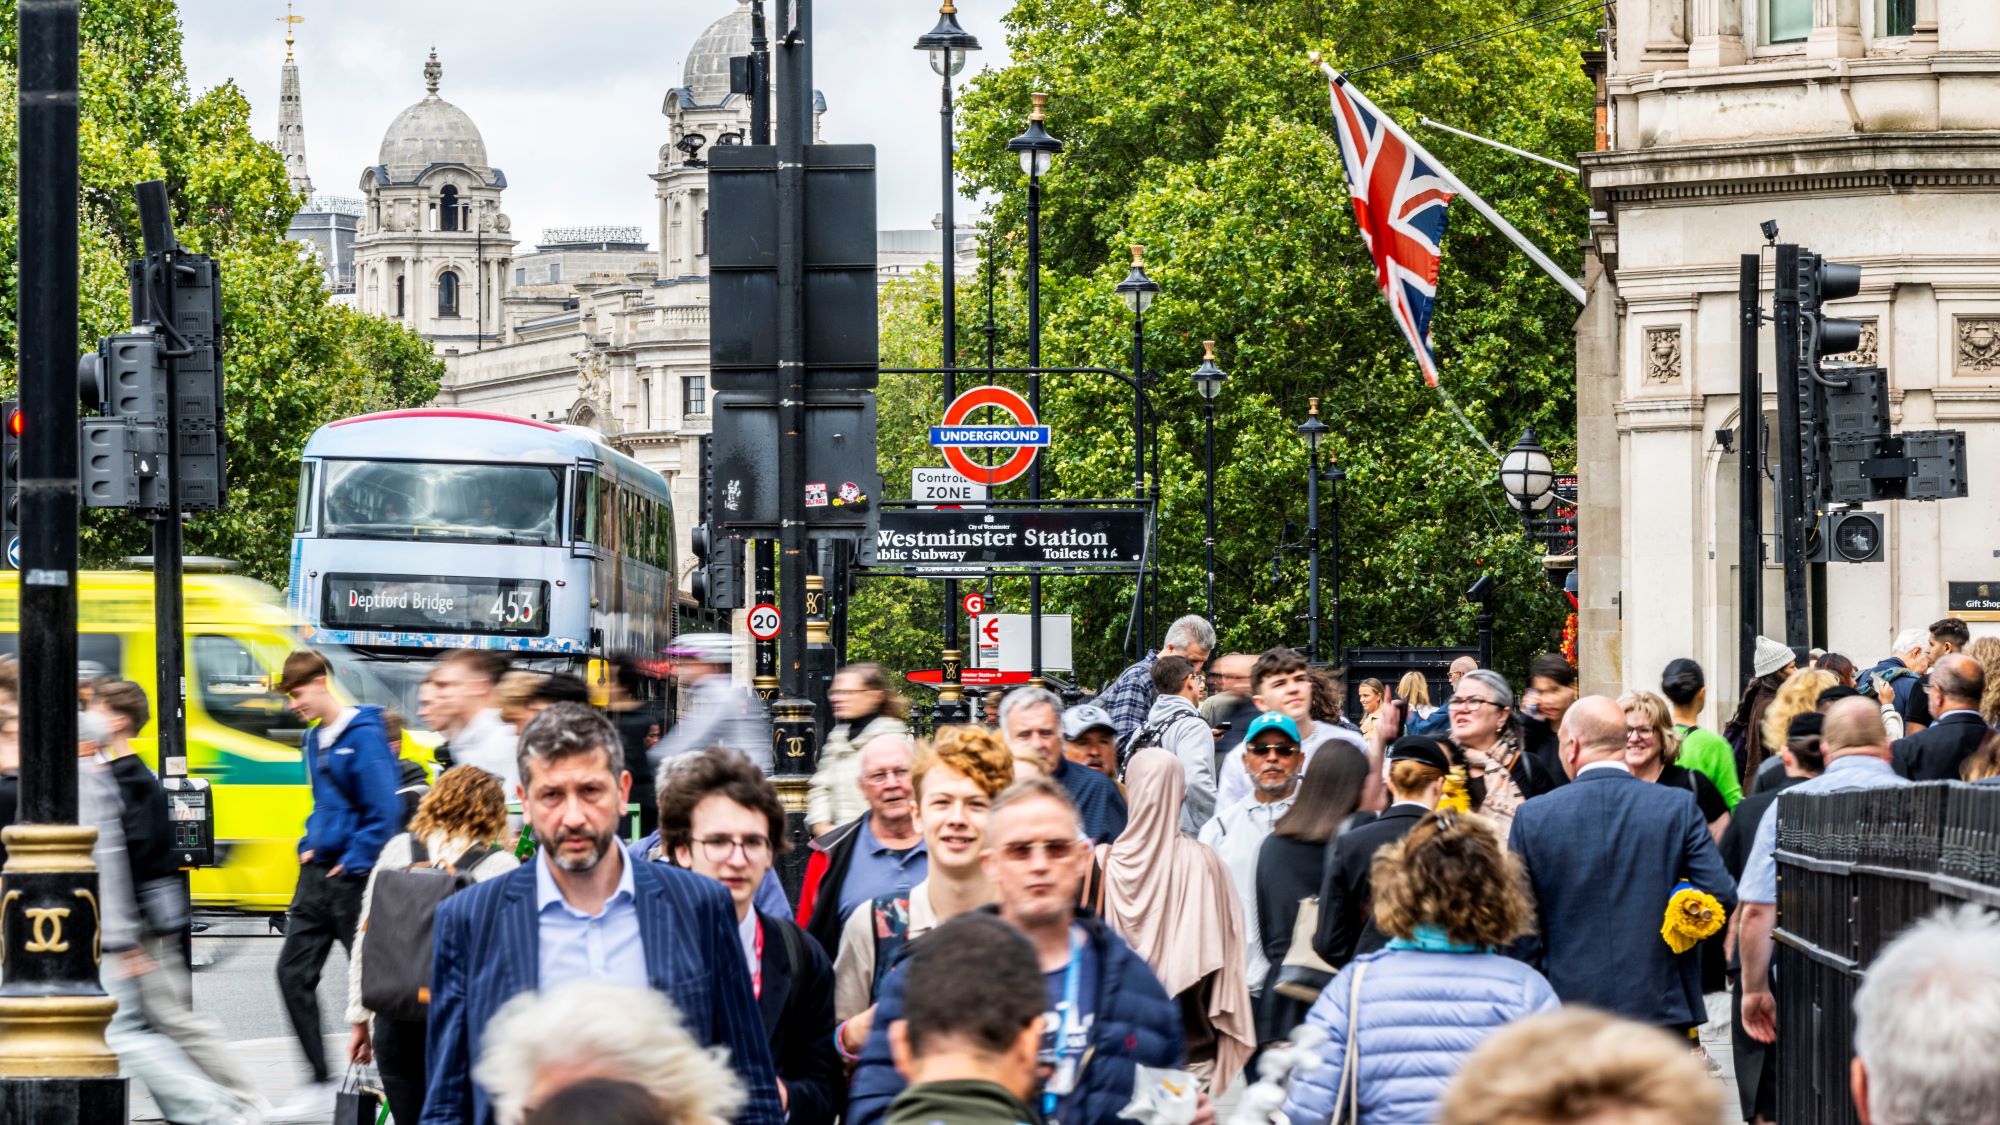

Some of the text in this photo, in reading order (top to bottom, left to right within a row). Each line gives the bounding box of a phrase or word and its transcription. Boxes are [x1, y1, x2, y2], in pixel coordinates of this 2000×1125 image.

[940, 430, 1039, 441] UNDERGROUND
[926, 486, 972, 499] ZONE
[877, 528, 1108, 547] Westminster Station
[912, 548, 967, 562] Subway
[1043, 547, 1090, 559] Toilets
[349, 589, 533, 623] Deptford Bridge 453
[967, 597, 981, 612] G
[1965, 600, 1981, 608] Gift
[753, 614, 778, 629] 20
